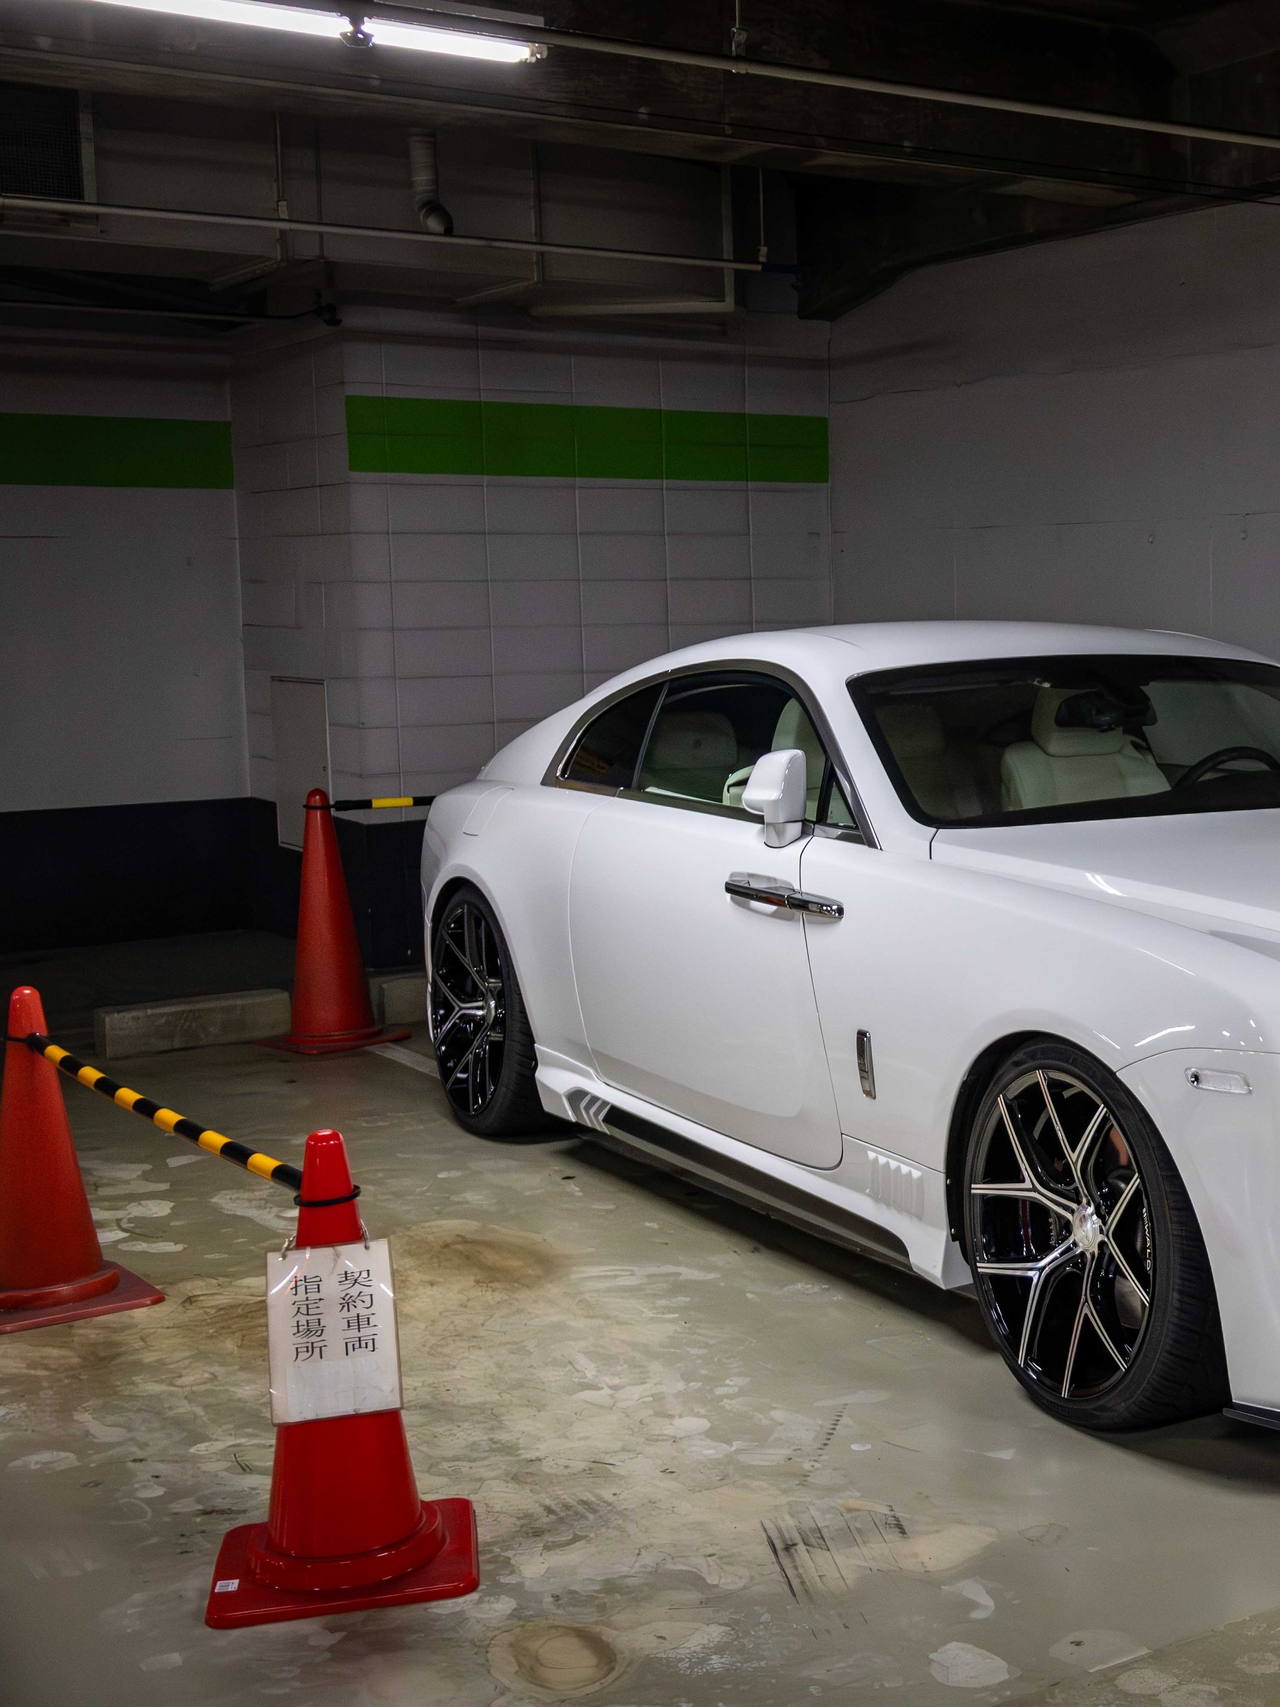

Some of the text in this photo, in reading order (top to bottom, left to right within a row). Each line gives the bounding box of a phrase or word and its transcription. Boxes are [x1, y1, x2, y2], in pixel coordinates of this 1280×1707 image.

[290, 1275, 328, 1363] 指定場所
[337, 1269, 379, 1357] 契約車両
